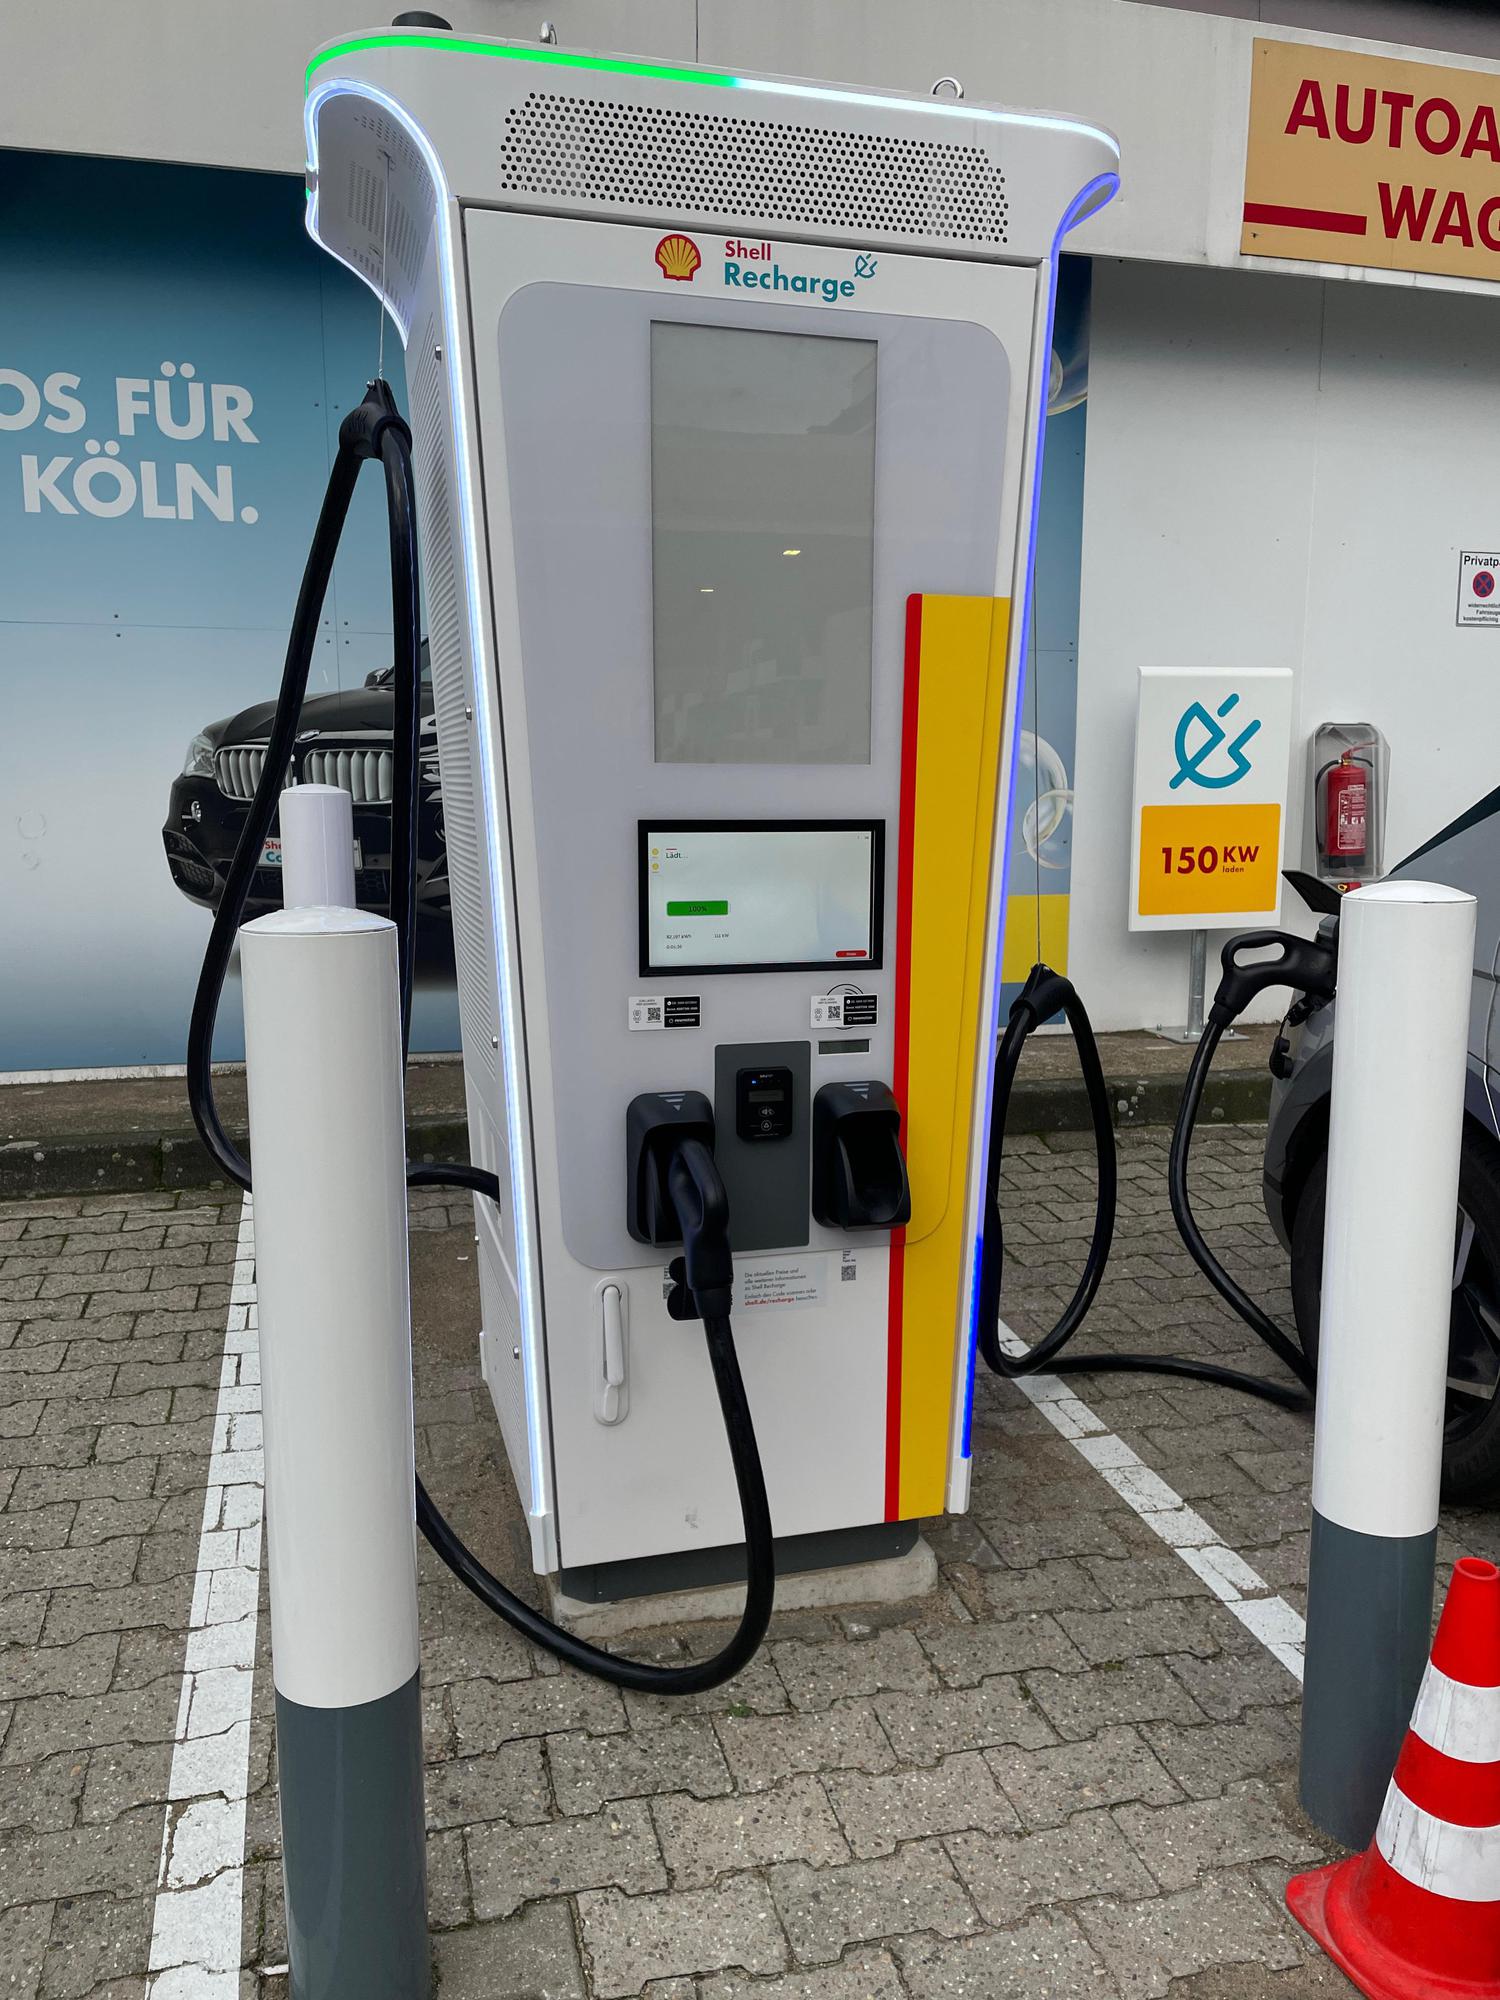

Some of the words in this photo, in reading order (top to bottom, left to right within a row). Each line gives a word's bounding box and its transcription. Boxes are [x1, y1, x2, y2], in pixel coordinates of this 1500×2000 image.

[724, 240, 771, 261] Shell
[724, 261, 855, 303] Recharge
[115, 360, 260, 443] FÜR
[20, 439, 260, 525] KÖLN.
[1464, 555, 1500, 568] Privatp
[1161, 845, 1219, 875] 150
[1223, 845, 1260, 863] KW
[1222, 865, 1245, 873] laden
[688, 905, 707, 913] 100%
